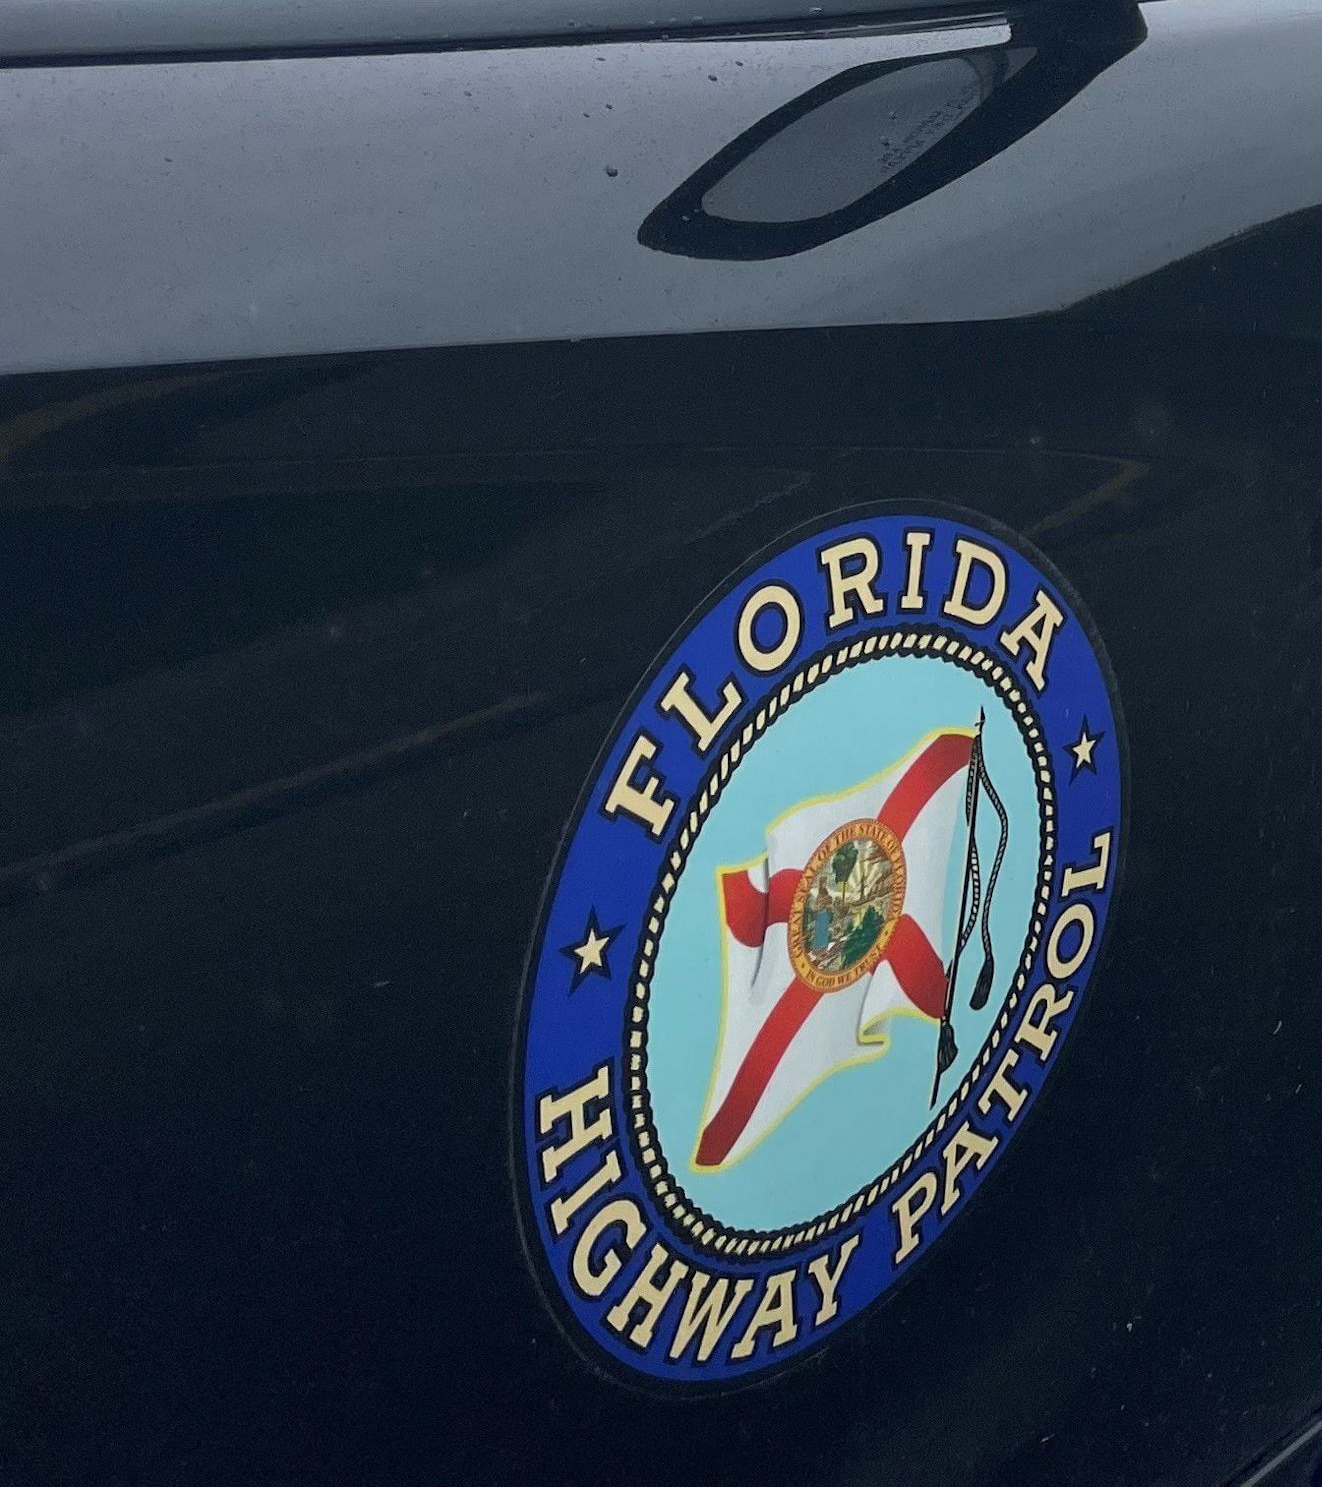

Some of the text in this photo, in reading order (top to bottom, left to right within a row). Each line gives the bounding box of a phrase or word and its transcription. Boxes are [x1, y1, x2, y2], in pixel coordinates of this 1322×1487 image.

[604, 532, 1065, 836] FLORIDA
[540, 833, 1112, 1361] HIGHWAY PATROL
